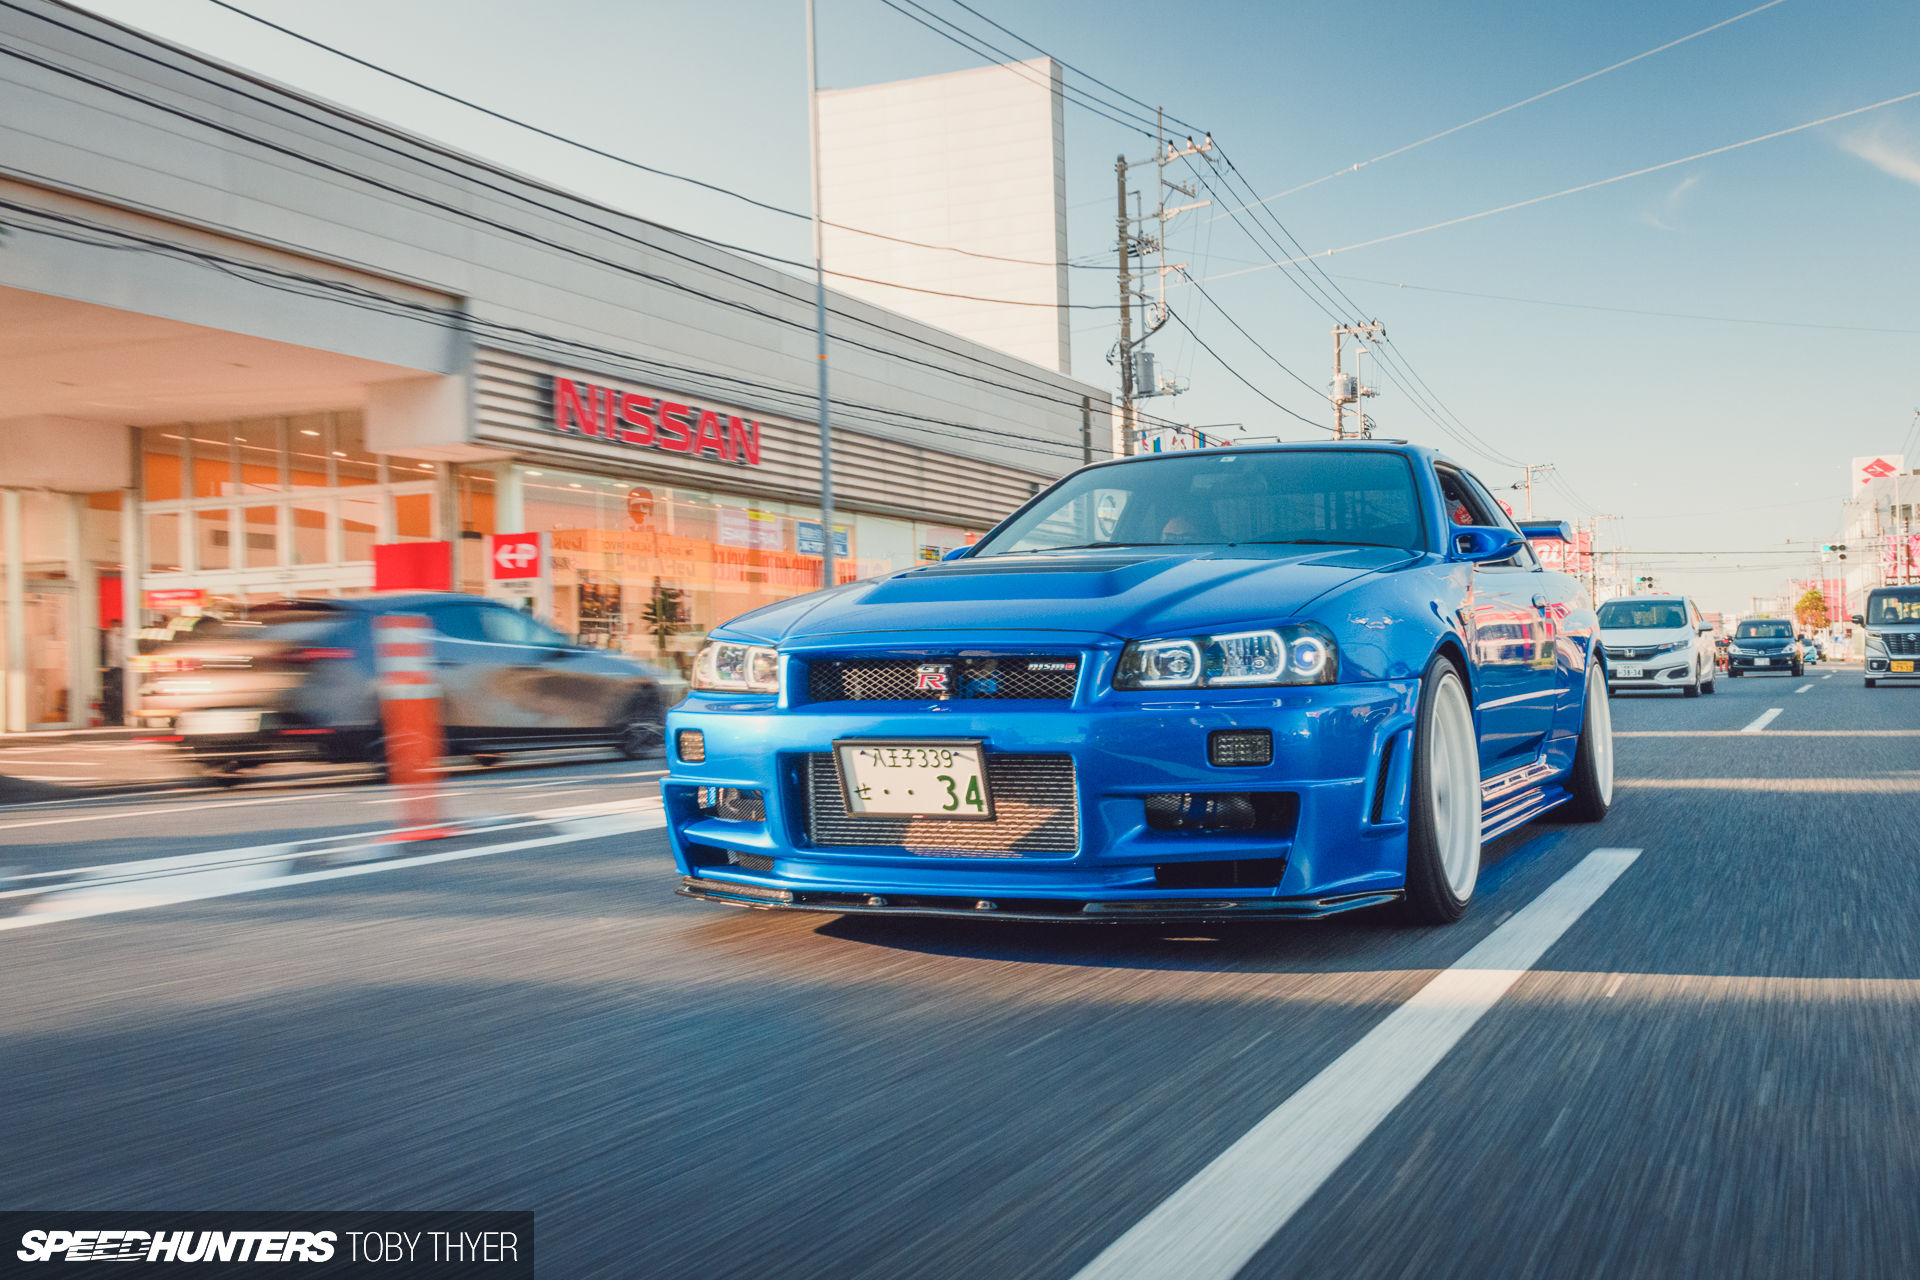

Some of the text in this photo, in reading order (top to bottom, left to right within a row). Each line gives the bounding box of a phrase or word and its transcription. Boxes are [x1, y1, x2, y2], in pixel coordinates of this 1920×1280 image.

[554, 377, 760, 466] NISSAN
[915, 673, 949, 690] R
[936, 775, 983, 812] 34
